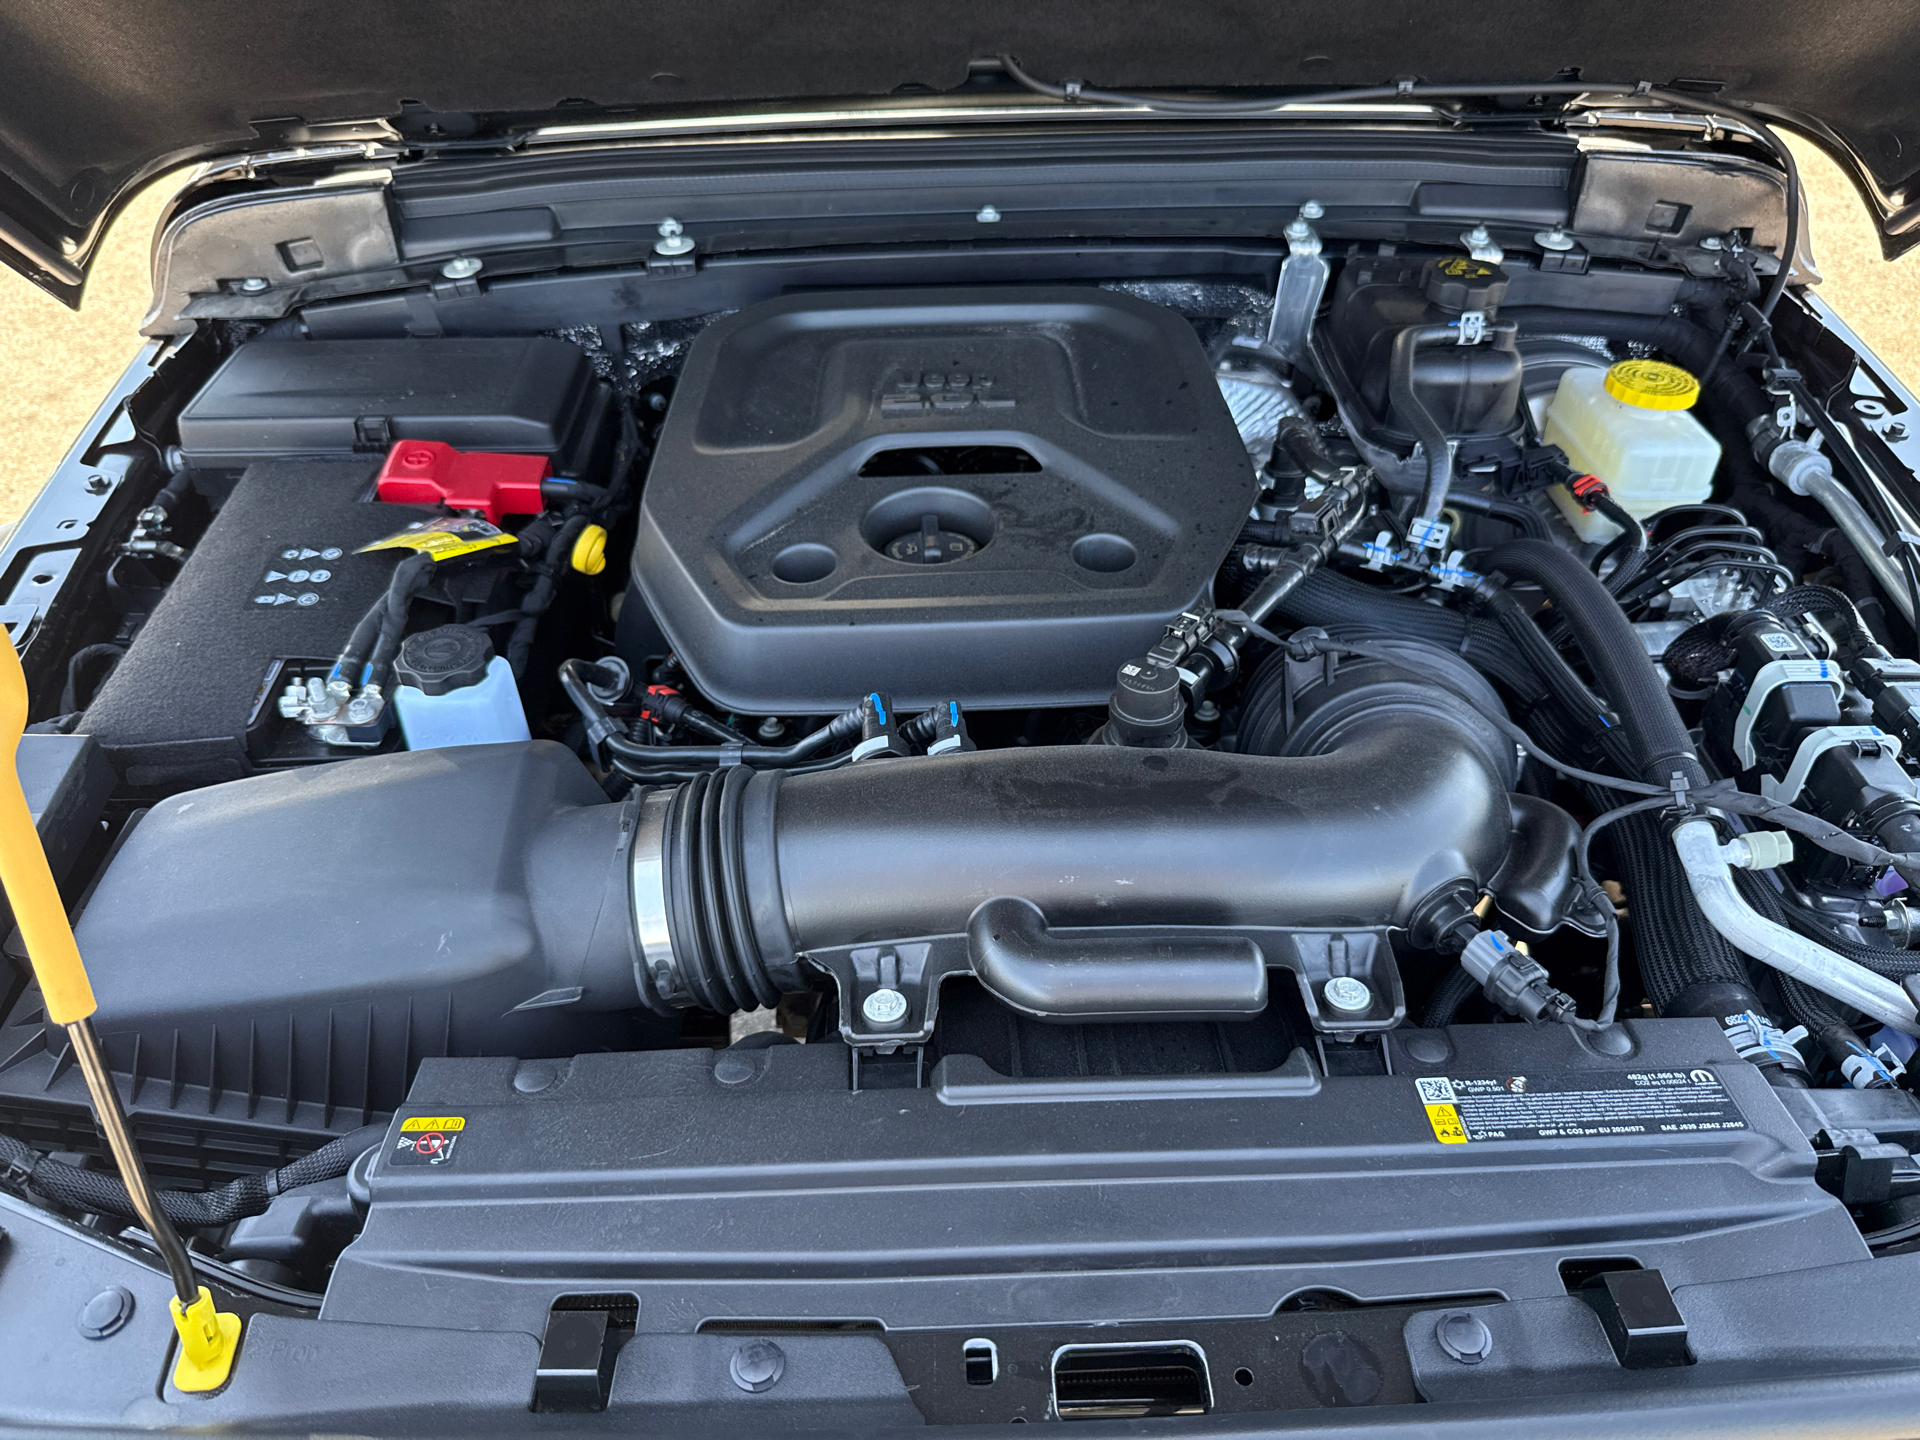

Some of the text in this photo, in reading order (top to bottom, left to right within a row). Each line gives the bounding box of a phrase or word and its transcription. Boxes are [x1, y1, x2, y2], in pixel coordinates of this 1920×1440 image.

[896, 369, 994, 391] Jeep
[1465, 1079, 1497, 1087] R-1234yf
[1611, 1125, 1645, 1133] 2024/573
